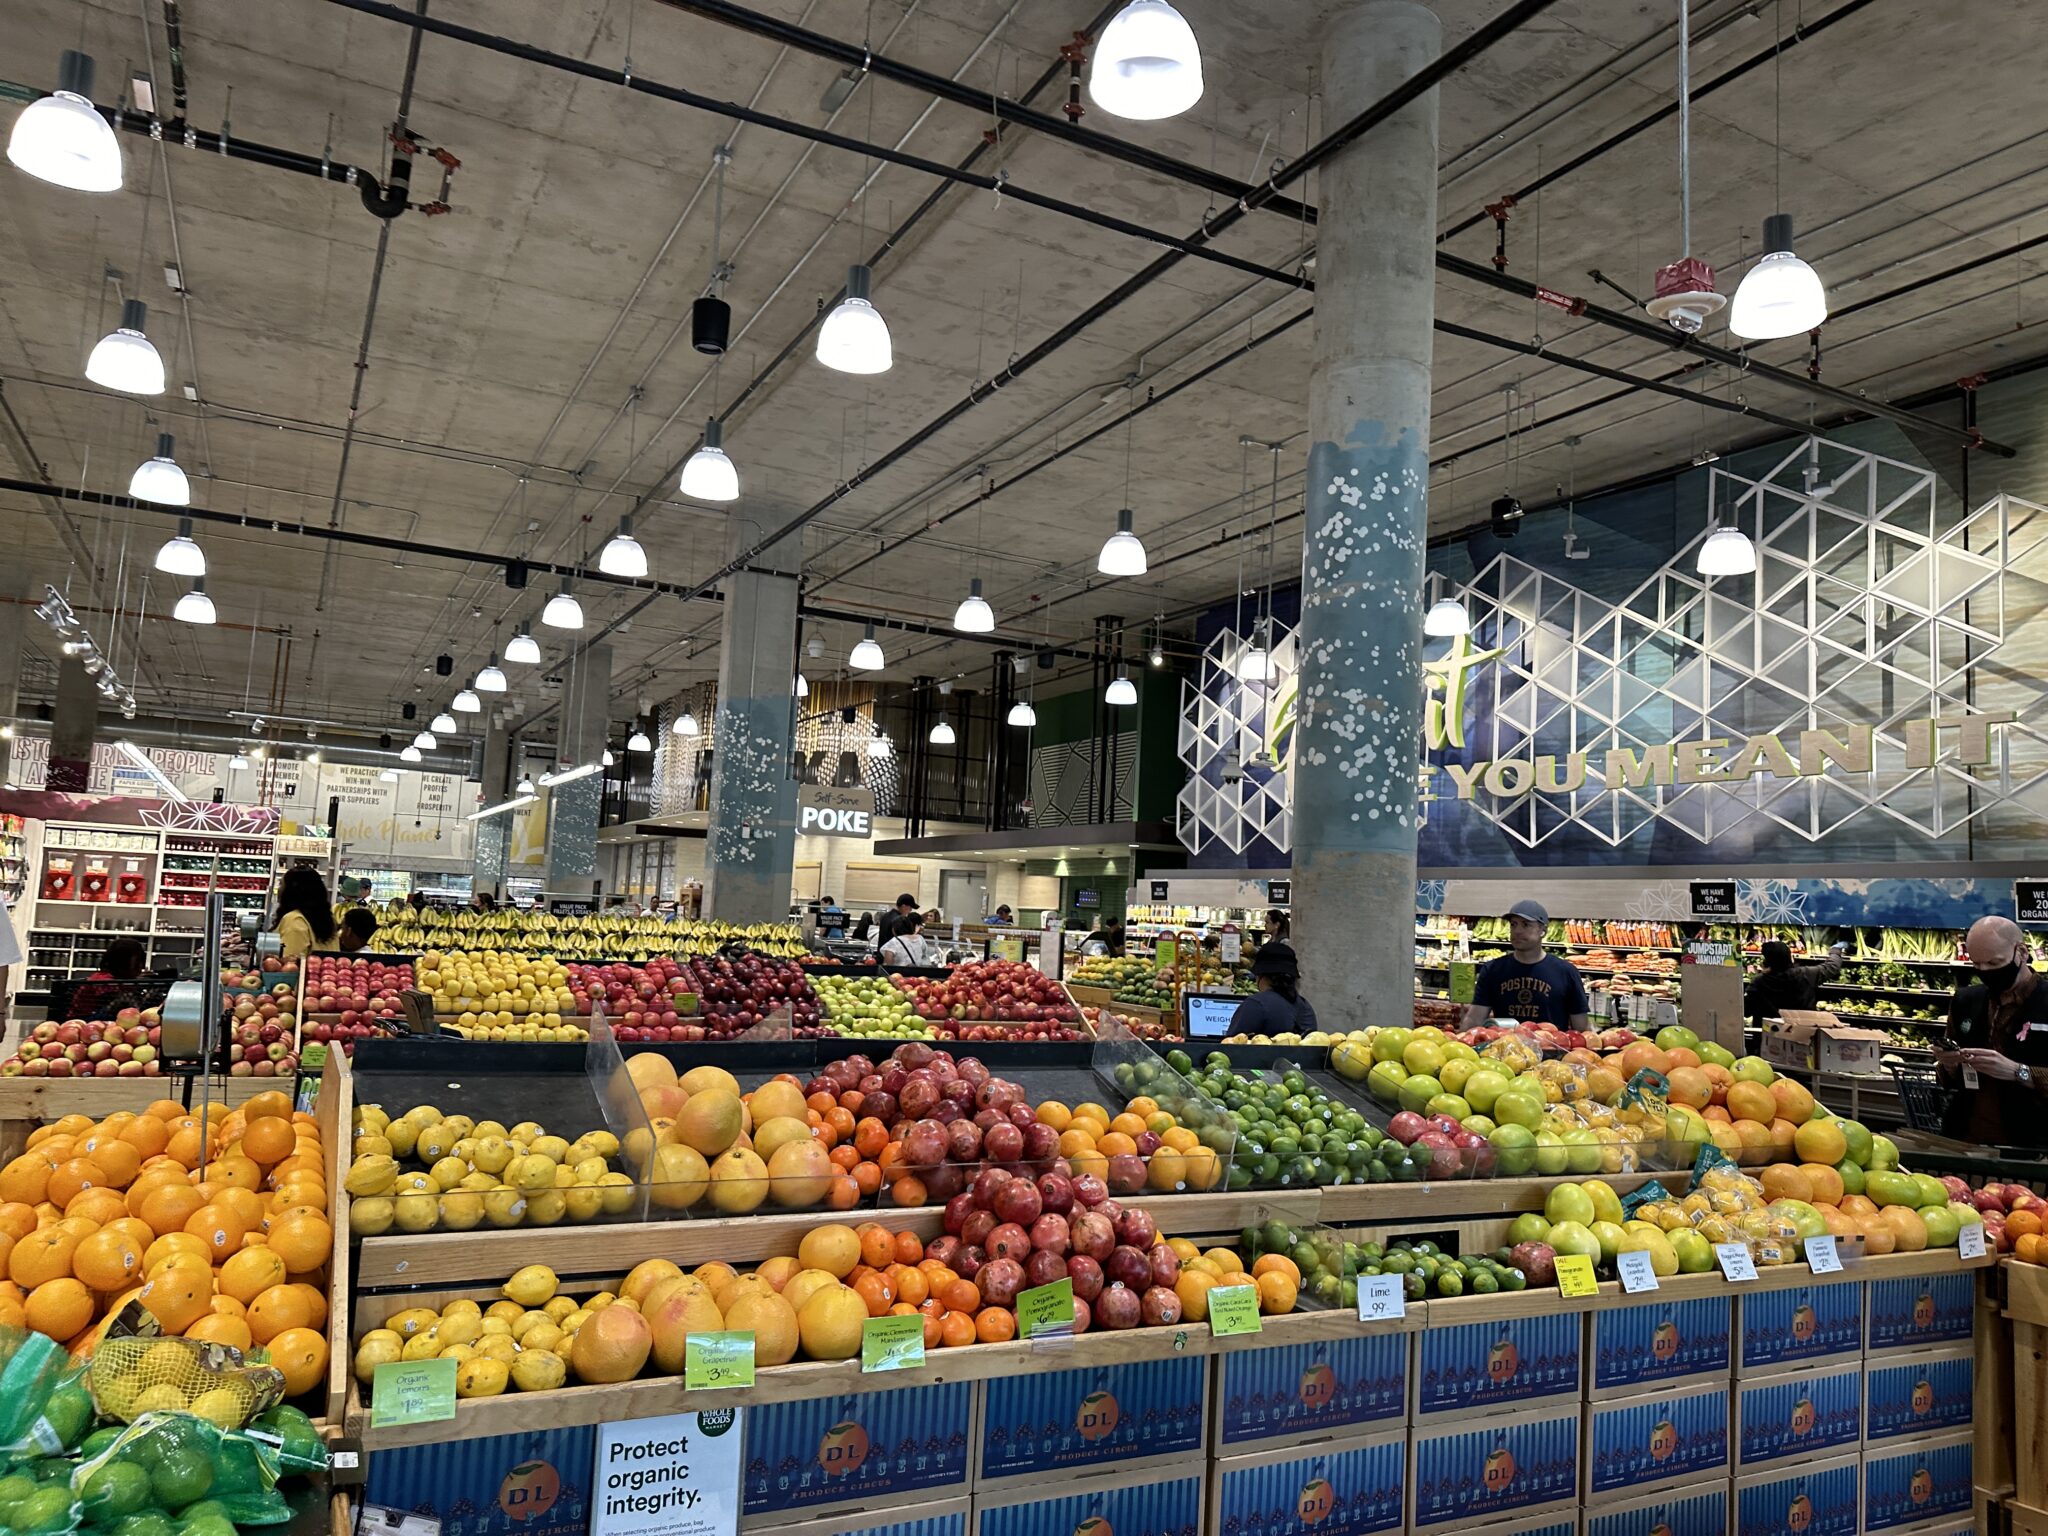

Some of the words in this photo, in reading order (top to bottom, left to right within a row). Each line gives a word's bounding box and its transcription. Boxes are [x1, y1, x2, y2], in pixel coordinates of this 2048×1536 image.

[1445, 752, 1587, 800] YOU
[1605, 724, 1873, 790] MEAN
[1905, 711, 2017, 769] IT
[154, 752, 216, 775] PEOPLE
[350, 767, 379, 777] PRACTICE
[326, 785, 372, 795] PARTNERSHIPS
[372, 788, 388, 796] WITH
[429, 793, 441, 801] AND
[347, 796, 380, 805] SUPPLIERS
[802, 806, 869, 833] POKE
[1700, 888, 1709, 896] WE
[1710, 888, 1724, 896] HAVE
[2033, 891, 2045, 899] WE
[1713, 904, 1730, 912] ITEMS
[1688, 942, 1733, 956] JUMPSTART
[1695, 954, 1725, 966] JANUARY
[1501, 976, 1552, 997] POSITIVE
[1508, 1004, 1540, 1019] STATE
[1370, 1287, 1391, 1298] Lime
[702, 1408, 732, 1418] WHOLE
[703, 1415, 731, 1426] FOODS
[610, 1436, 688, 1462] Protect
[826, 1444, 861, 1462] DL
[607, 1460, 690, 1490] organic
[508, 1485, 550, 1505] DL
[791, 1486, 846, 1500] PRODUCE
[850, 1478, 893, 1491] CIRCUS
[606, 1486, 702, 1515] integrity.
[648, 1524, 669, 1533] organic
